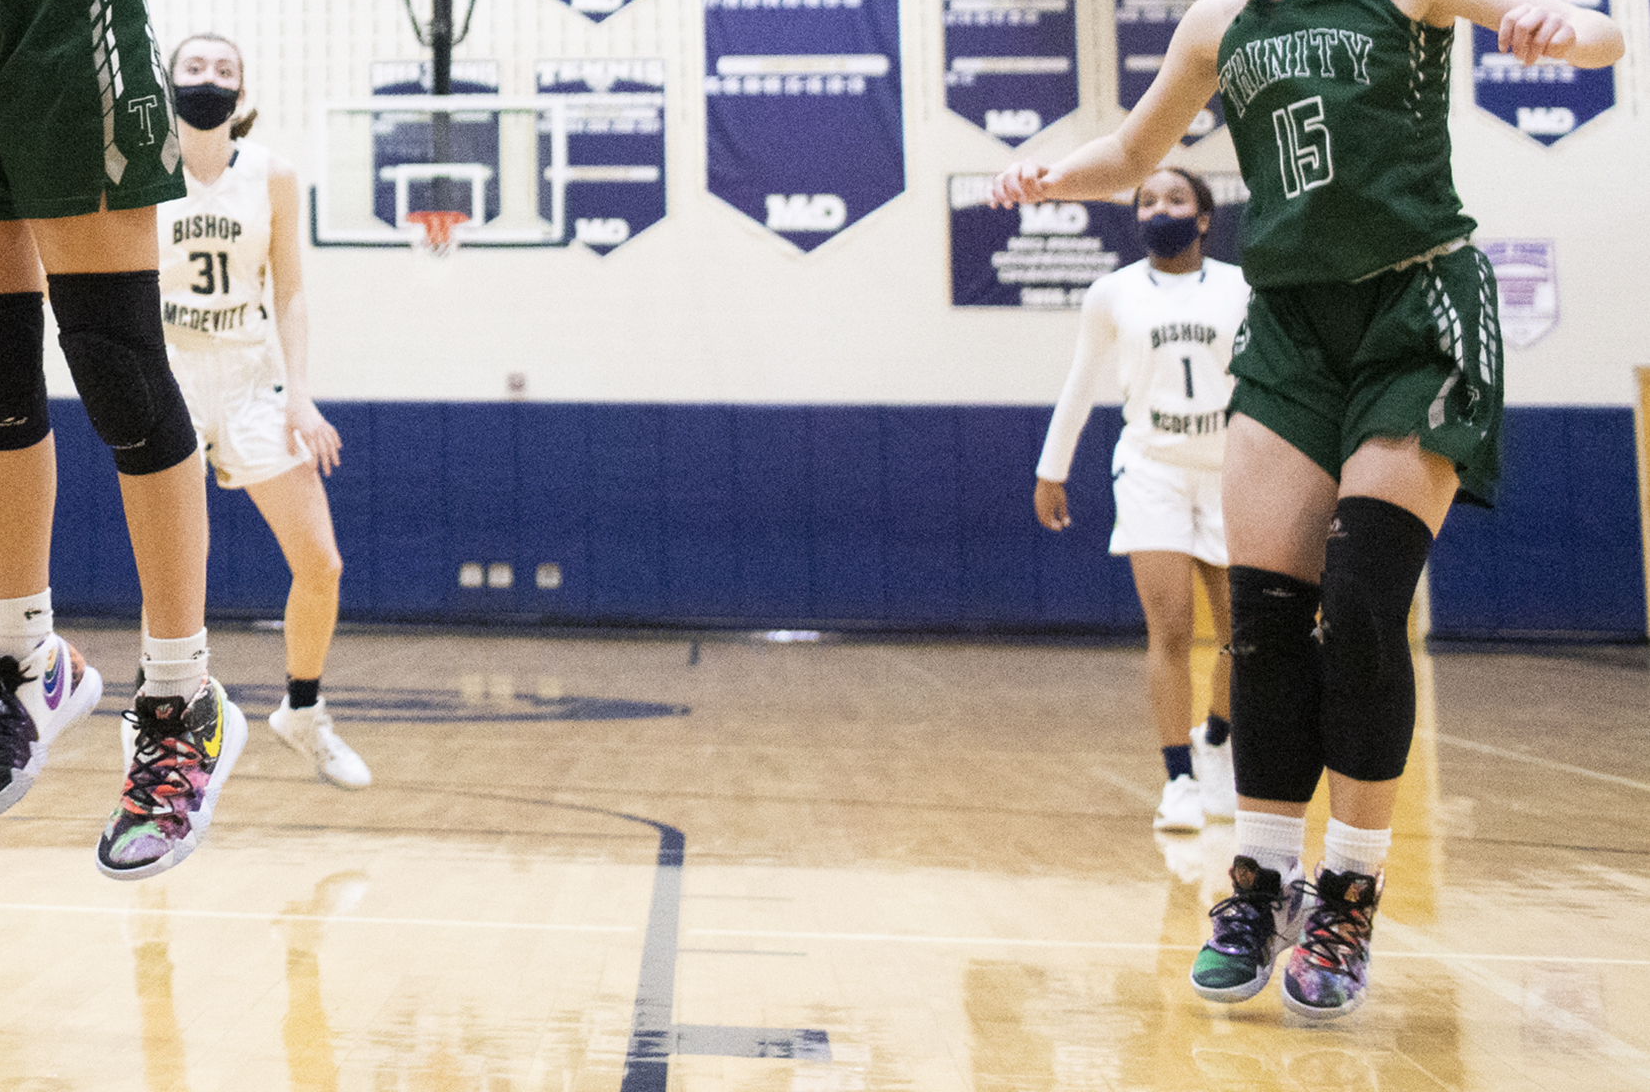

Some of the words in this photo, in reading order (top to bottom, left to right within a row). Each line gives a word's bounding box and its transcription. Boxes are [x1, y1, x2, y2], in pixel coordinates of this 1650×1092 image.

[1218, 28, 1373, 119] TRINITY
[128, 94, 158, 147] T
[1272, 95, 1334, 199] 15
[173, 214, 242, 244] BISHOP
[189, 251, 229, 294] 31
[1151, 323, 1216, 350] BISHOP
[1182, 357, 1194, 399] 1
